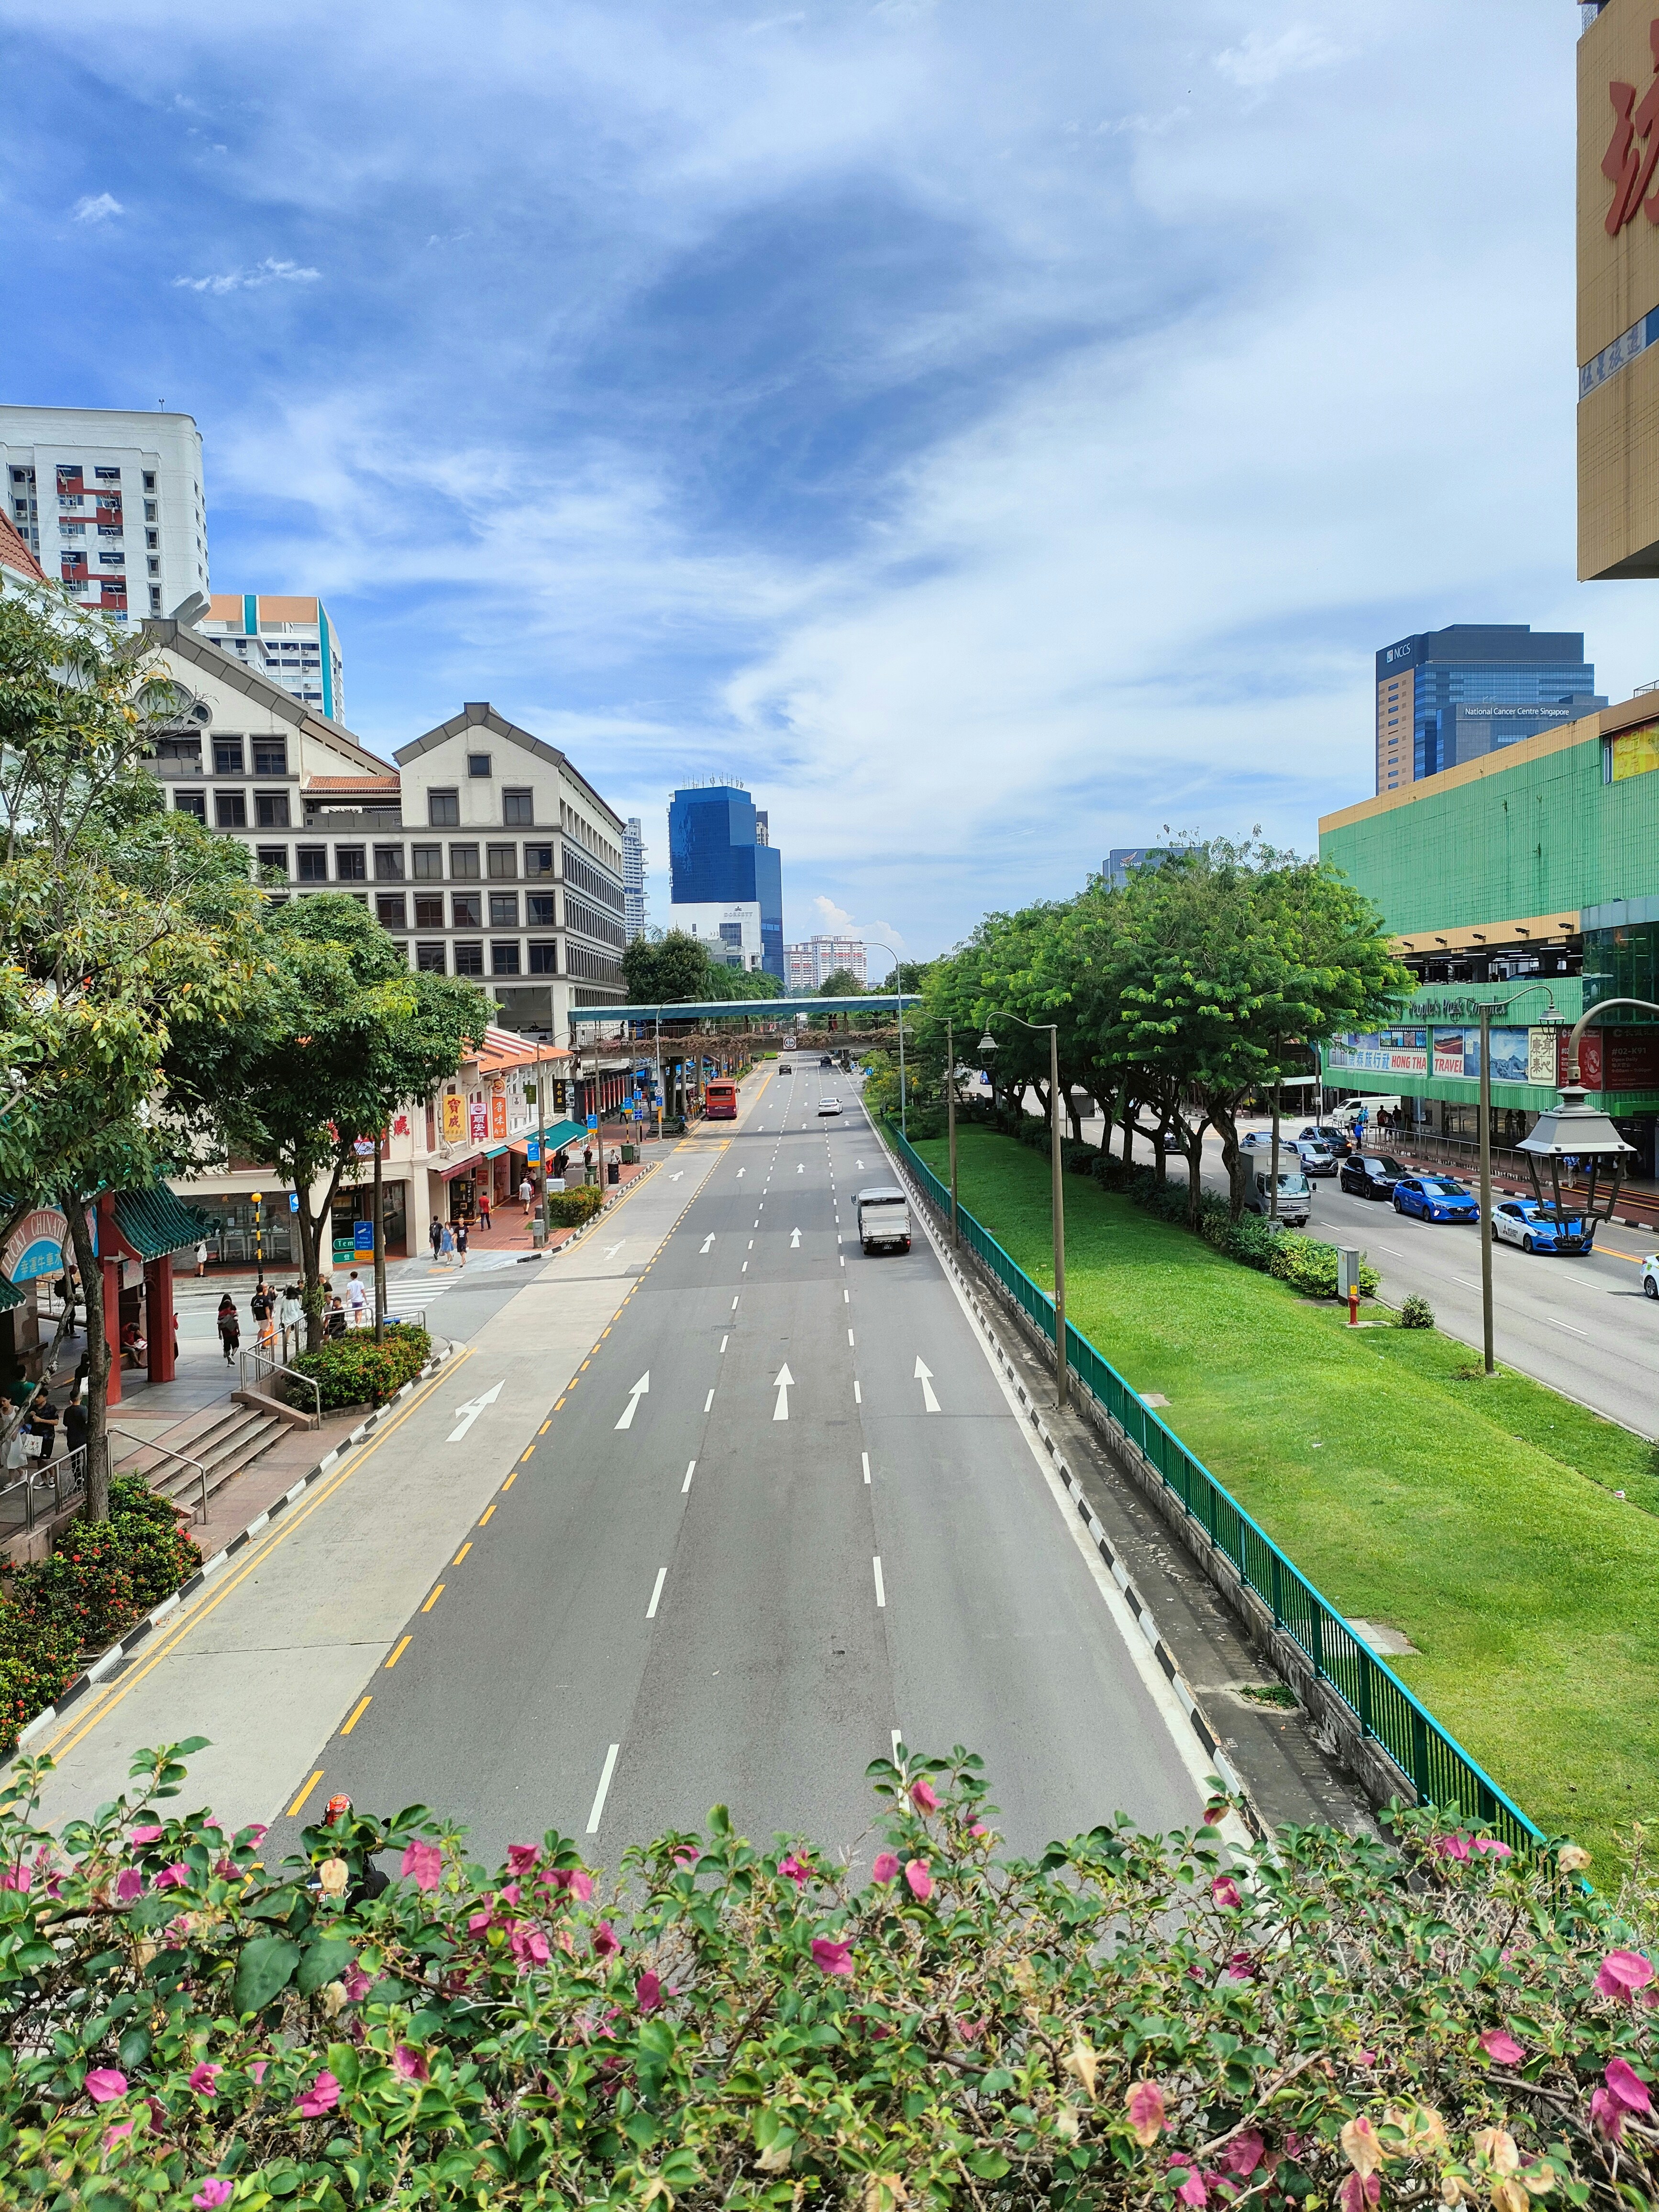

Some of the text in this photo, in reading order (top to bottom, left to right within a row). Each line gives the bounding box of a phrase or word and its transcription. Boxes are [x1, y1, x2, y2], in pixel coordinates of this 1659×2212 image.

[1394, 643, 1411, 660] NCCS
[1540, 708, 1570, 717] Singapore
[1409, 998, 1439, 1021] People's
[1349, 1051, 1463, 1073] 康泰旅行社 HONG THA TRAVEL
[1612, 1047, 1647, 1056] #02-K91
[473, 1115, 486, 1132] 顺安
[494, 1101, 505, 1125] 香味
[31, 1214, 76, 1257] CHINATON
[2, 1225, 27, 1275] LUCKY
[21, 1250, 62, 1275] 幸運牛車水
